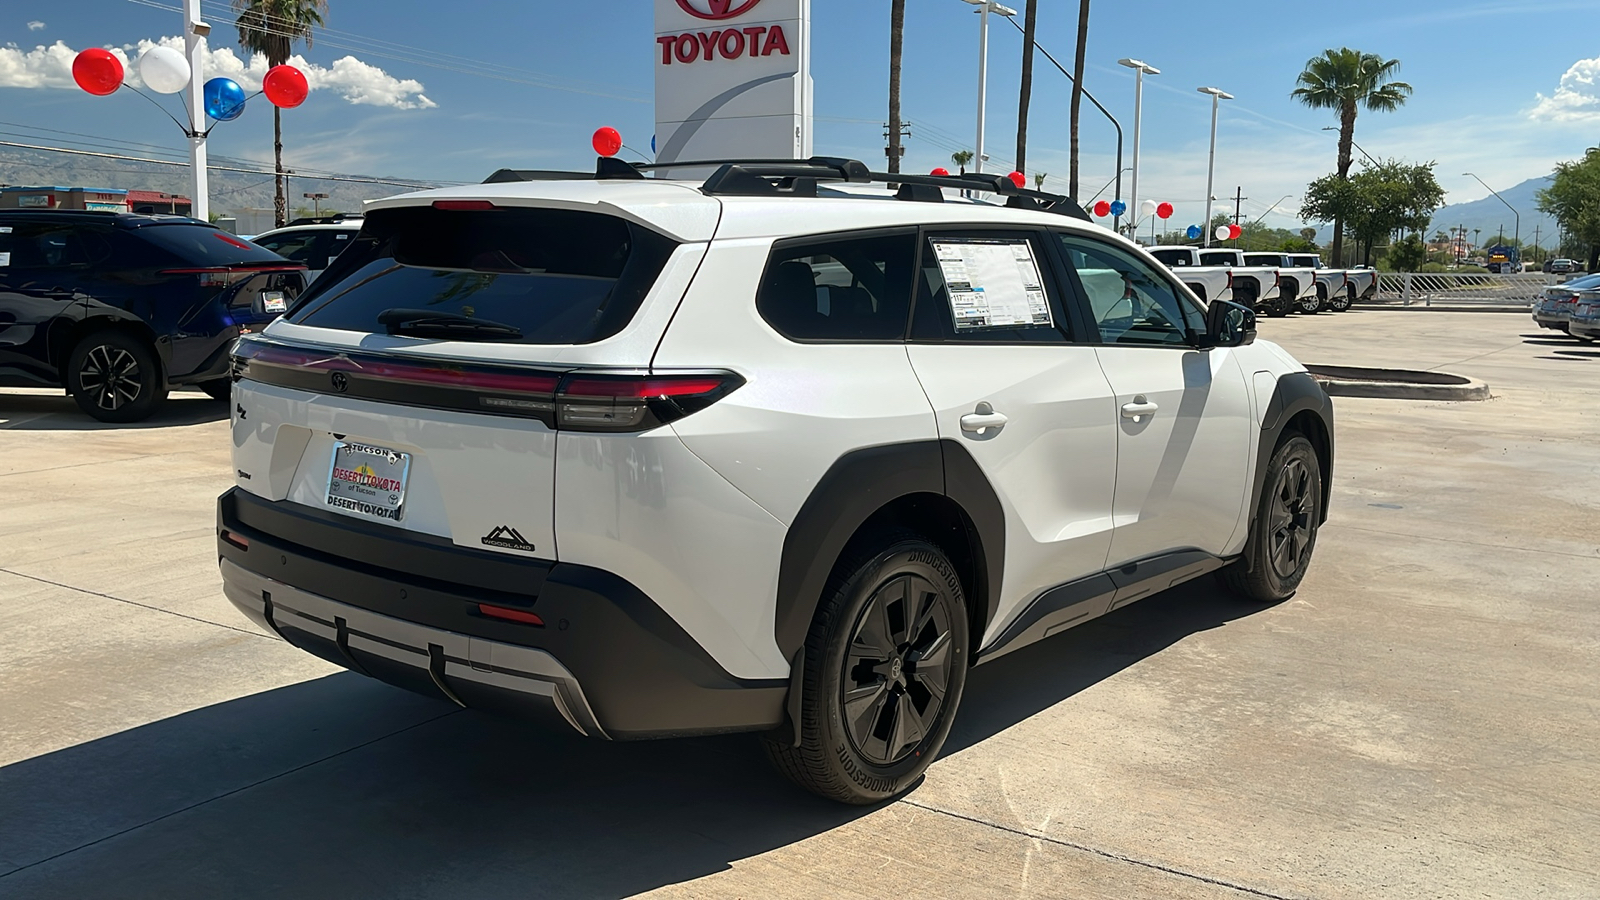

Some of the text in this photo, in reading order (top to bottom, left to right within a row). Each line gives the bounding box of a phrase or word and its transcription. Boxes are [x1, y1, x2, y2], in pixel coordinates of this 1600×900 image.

[656, 25, 791, 65] TOYOTA
[352, 444, 389, 457] TUCSON
[333, 468, 401, 493] DESERT TOYOTA
[348, 484, 376, 497] of Tucson
[327, 495, 394, 519] DESERT TOYOTA
[483, 539, 531, 550] WOODLAND
